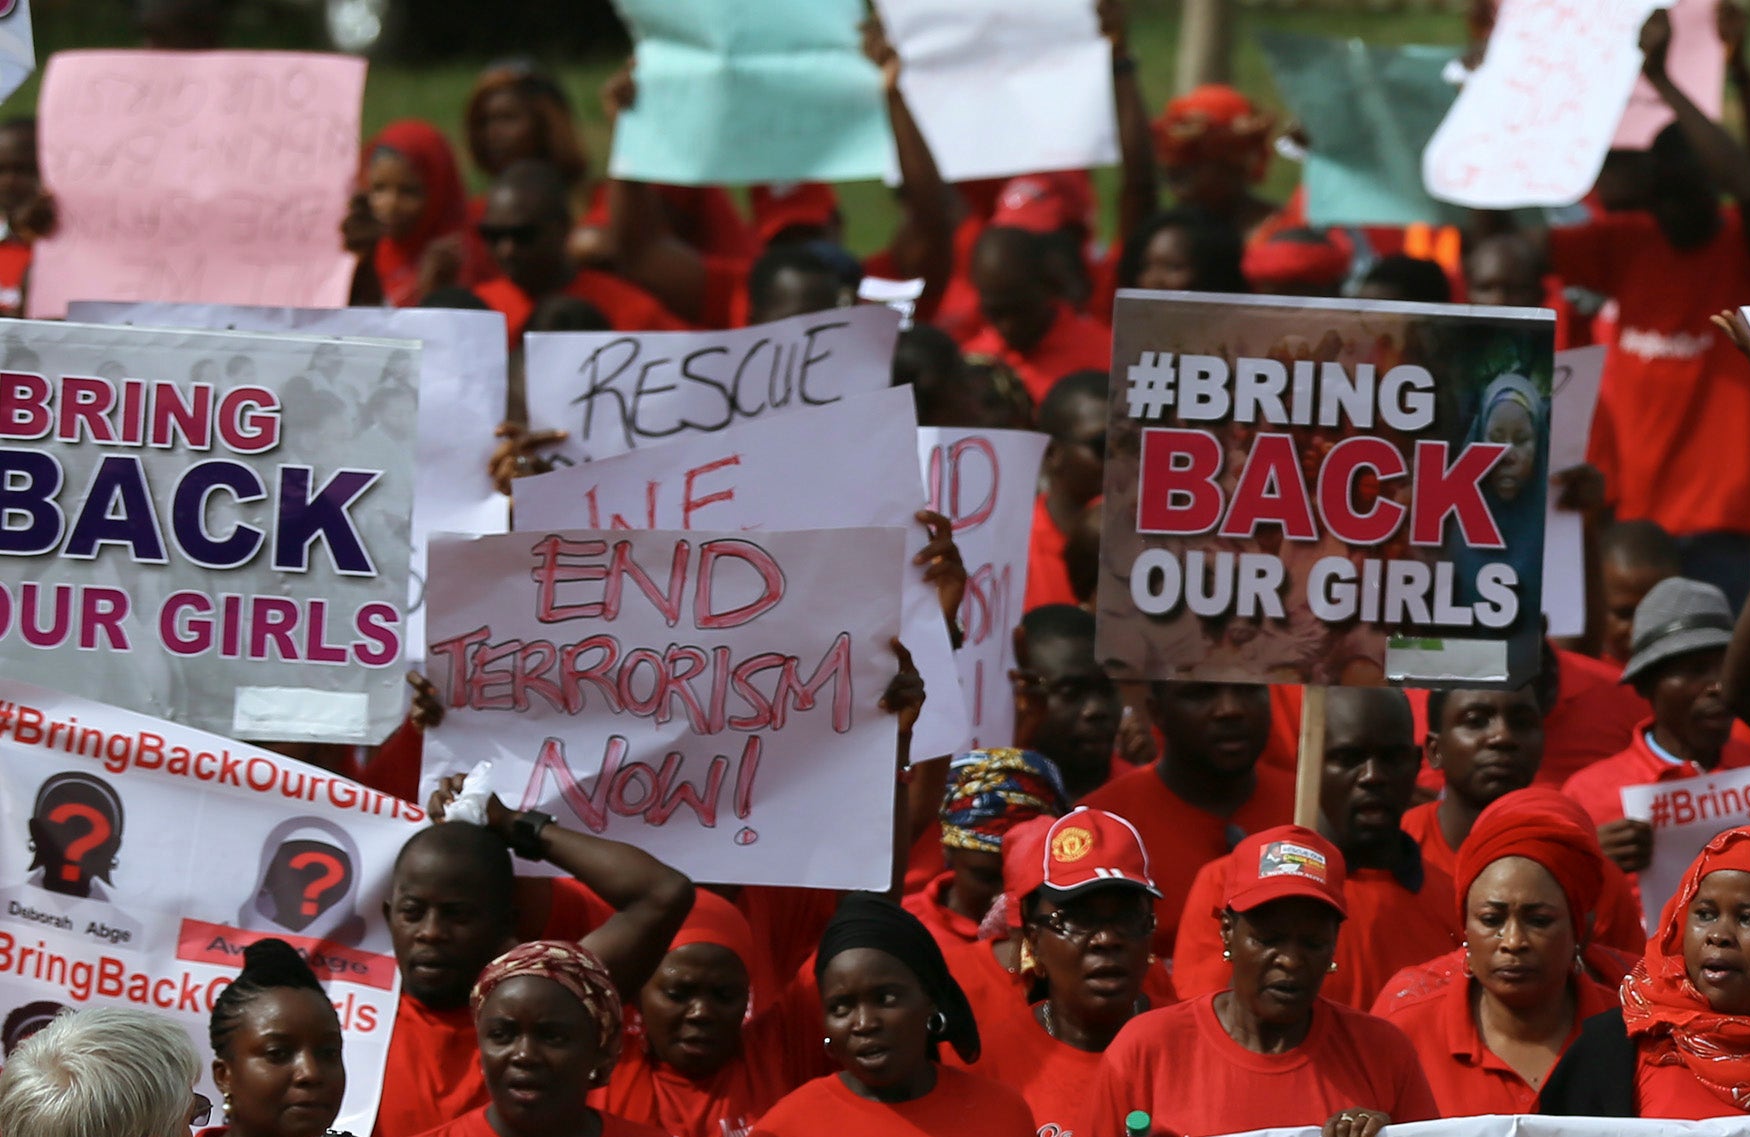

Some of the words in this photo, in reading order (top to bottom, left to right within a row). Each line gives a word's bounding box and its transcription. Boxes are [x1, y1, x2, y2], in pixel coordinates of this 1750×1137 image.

[0, 371, 282, 454] BRING
[570, 322, 852, 448] RESCUE
[1126, 351, 1436, 431] #BRING
[0, 449, 384, 578] BACK
[1136, 427, 1512, 549] BACK
[531, 534, 786, 630] END
[1129, 548, 1287, 619] OUR
[1307, 555, 1520, 628] GIRLS
[158, 588, 401, 668] GIRLS
[431, 626, 854, 734] TERRORISM
[84, 911, 132, 943] Abge
